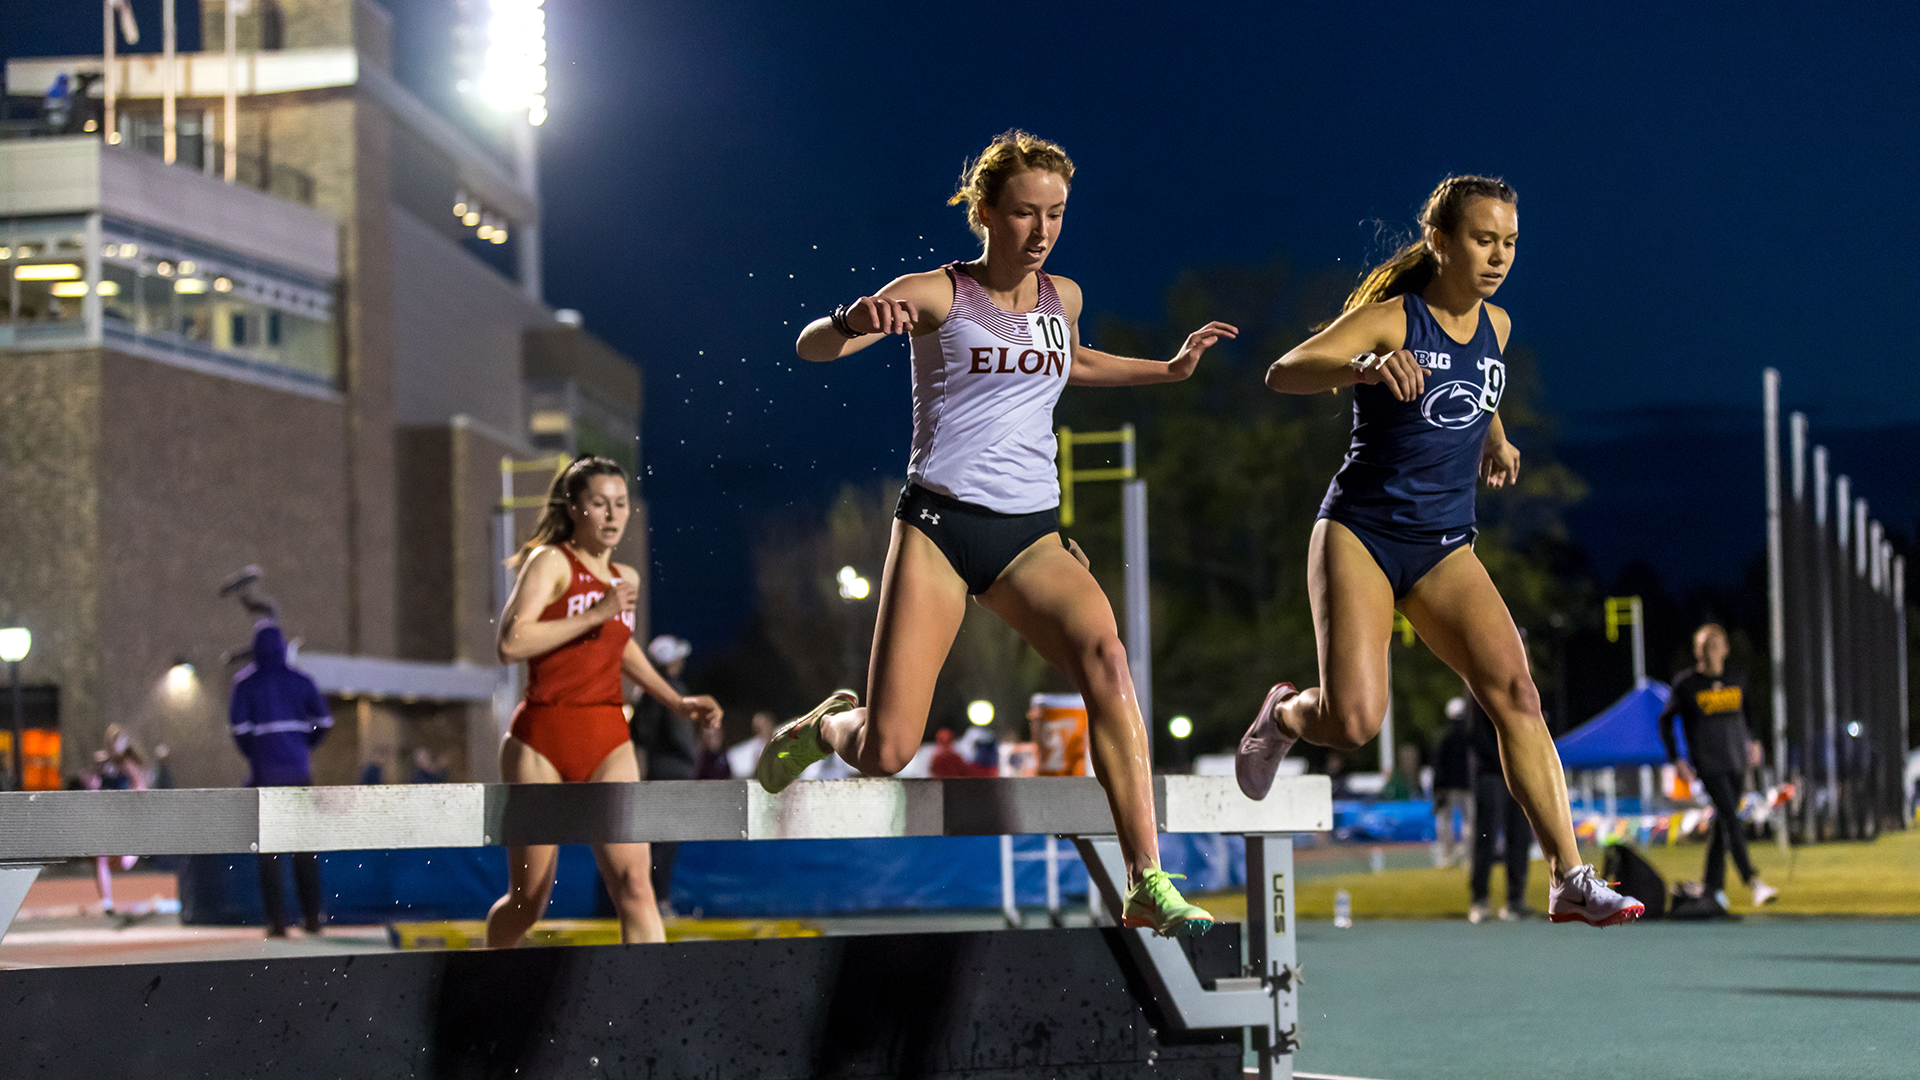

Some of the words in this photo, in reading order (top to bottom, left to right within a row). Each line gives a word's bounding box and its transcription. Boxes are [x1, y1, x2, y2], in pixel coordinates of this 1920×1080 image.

[1035, 315, 1064, 350] 10
[968, 347, 1066, 378] ELON
[1488, 363, 1503, 408] 9
[1273, 873, 1285, 933] UCS
